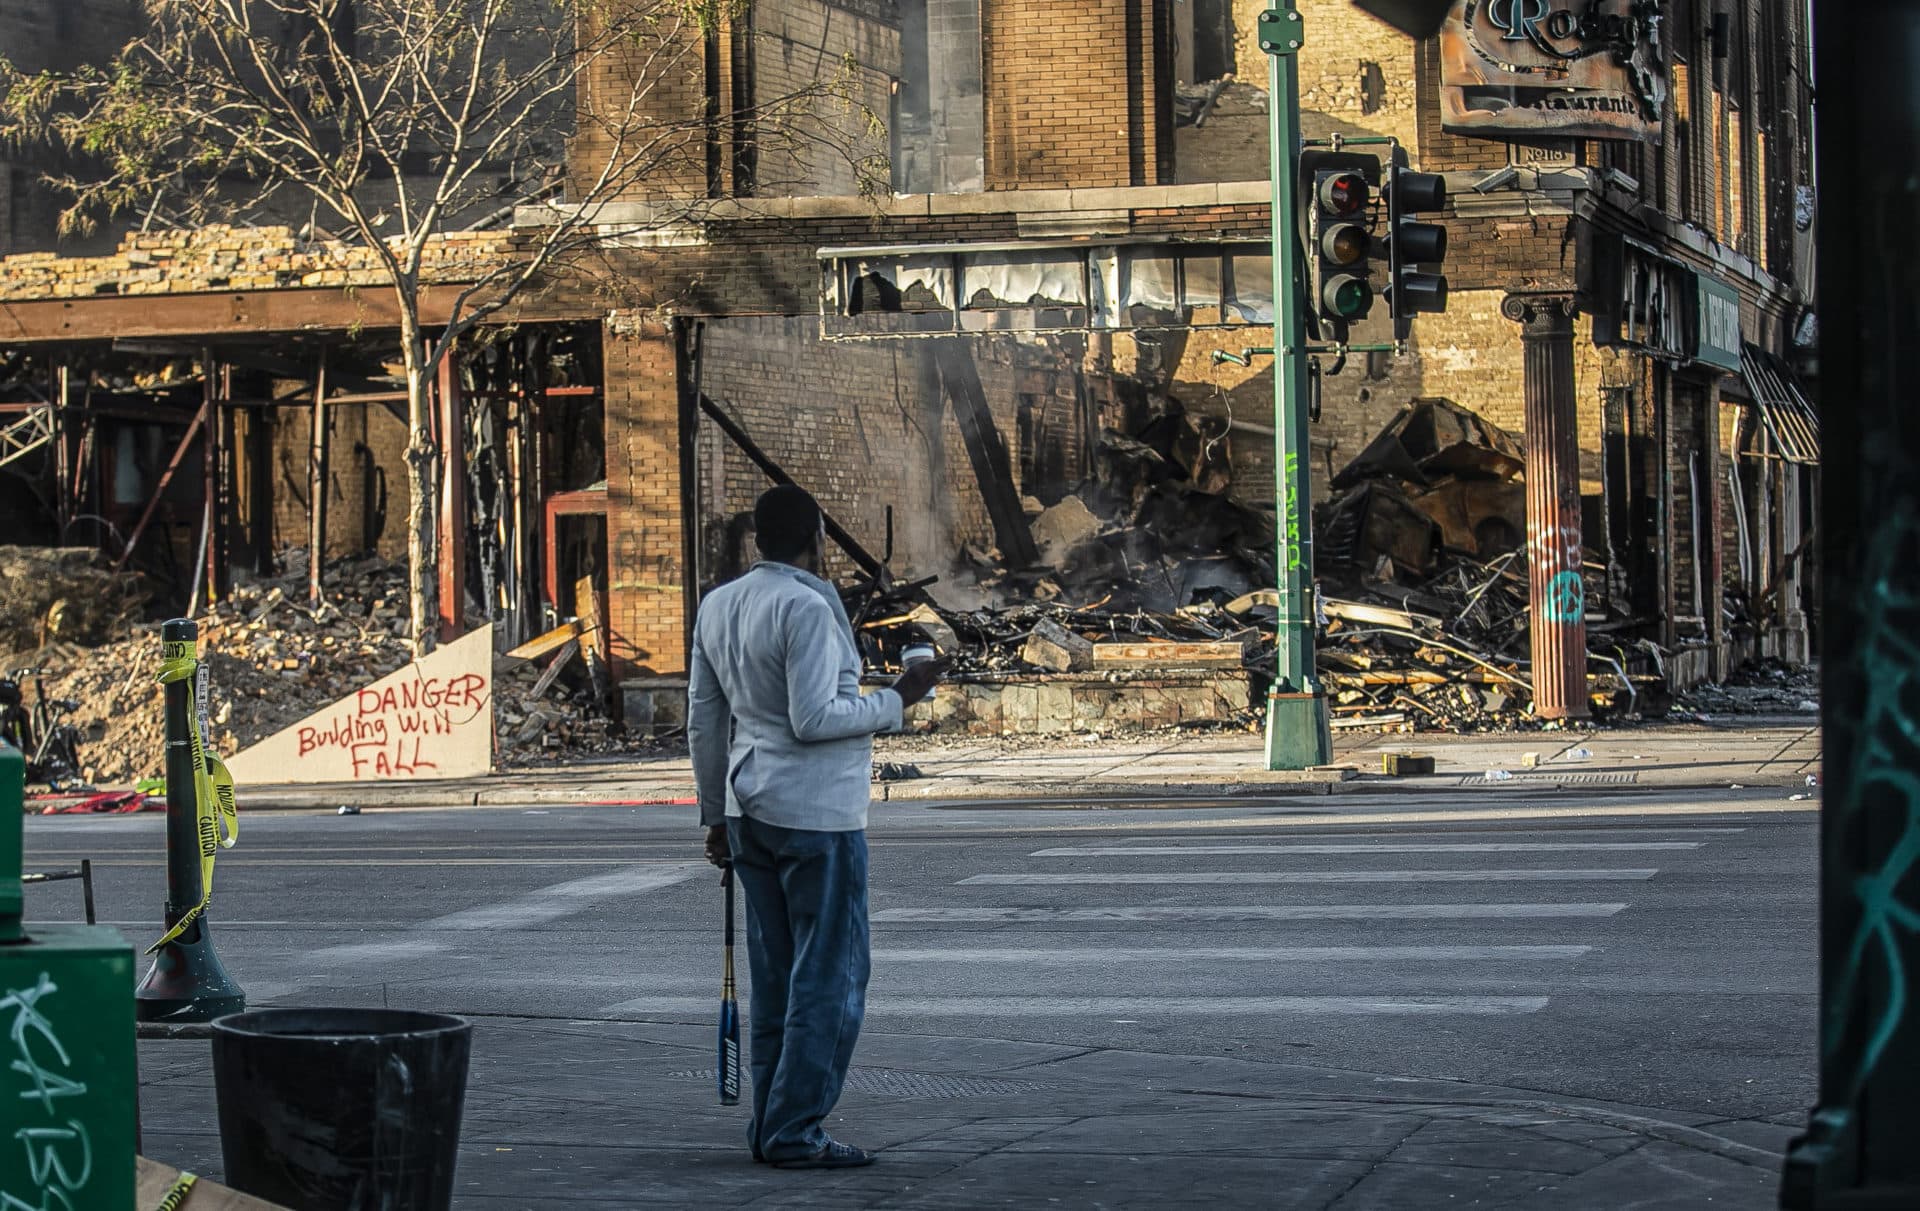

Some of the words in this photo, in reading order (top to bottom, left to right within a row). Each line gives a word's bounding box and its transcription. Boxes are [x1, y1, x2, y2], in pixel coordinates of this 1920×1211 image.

[357, 673, 486, 718] DANGER
[350, 736, 436, 778] FALL
[216, 784, 236, 817] CAUTION
[200, 815, 216, 858] CAUTION
